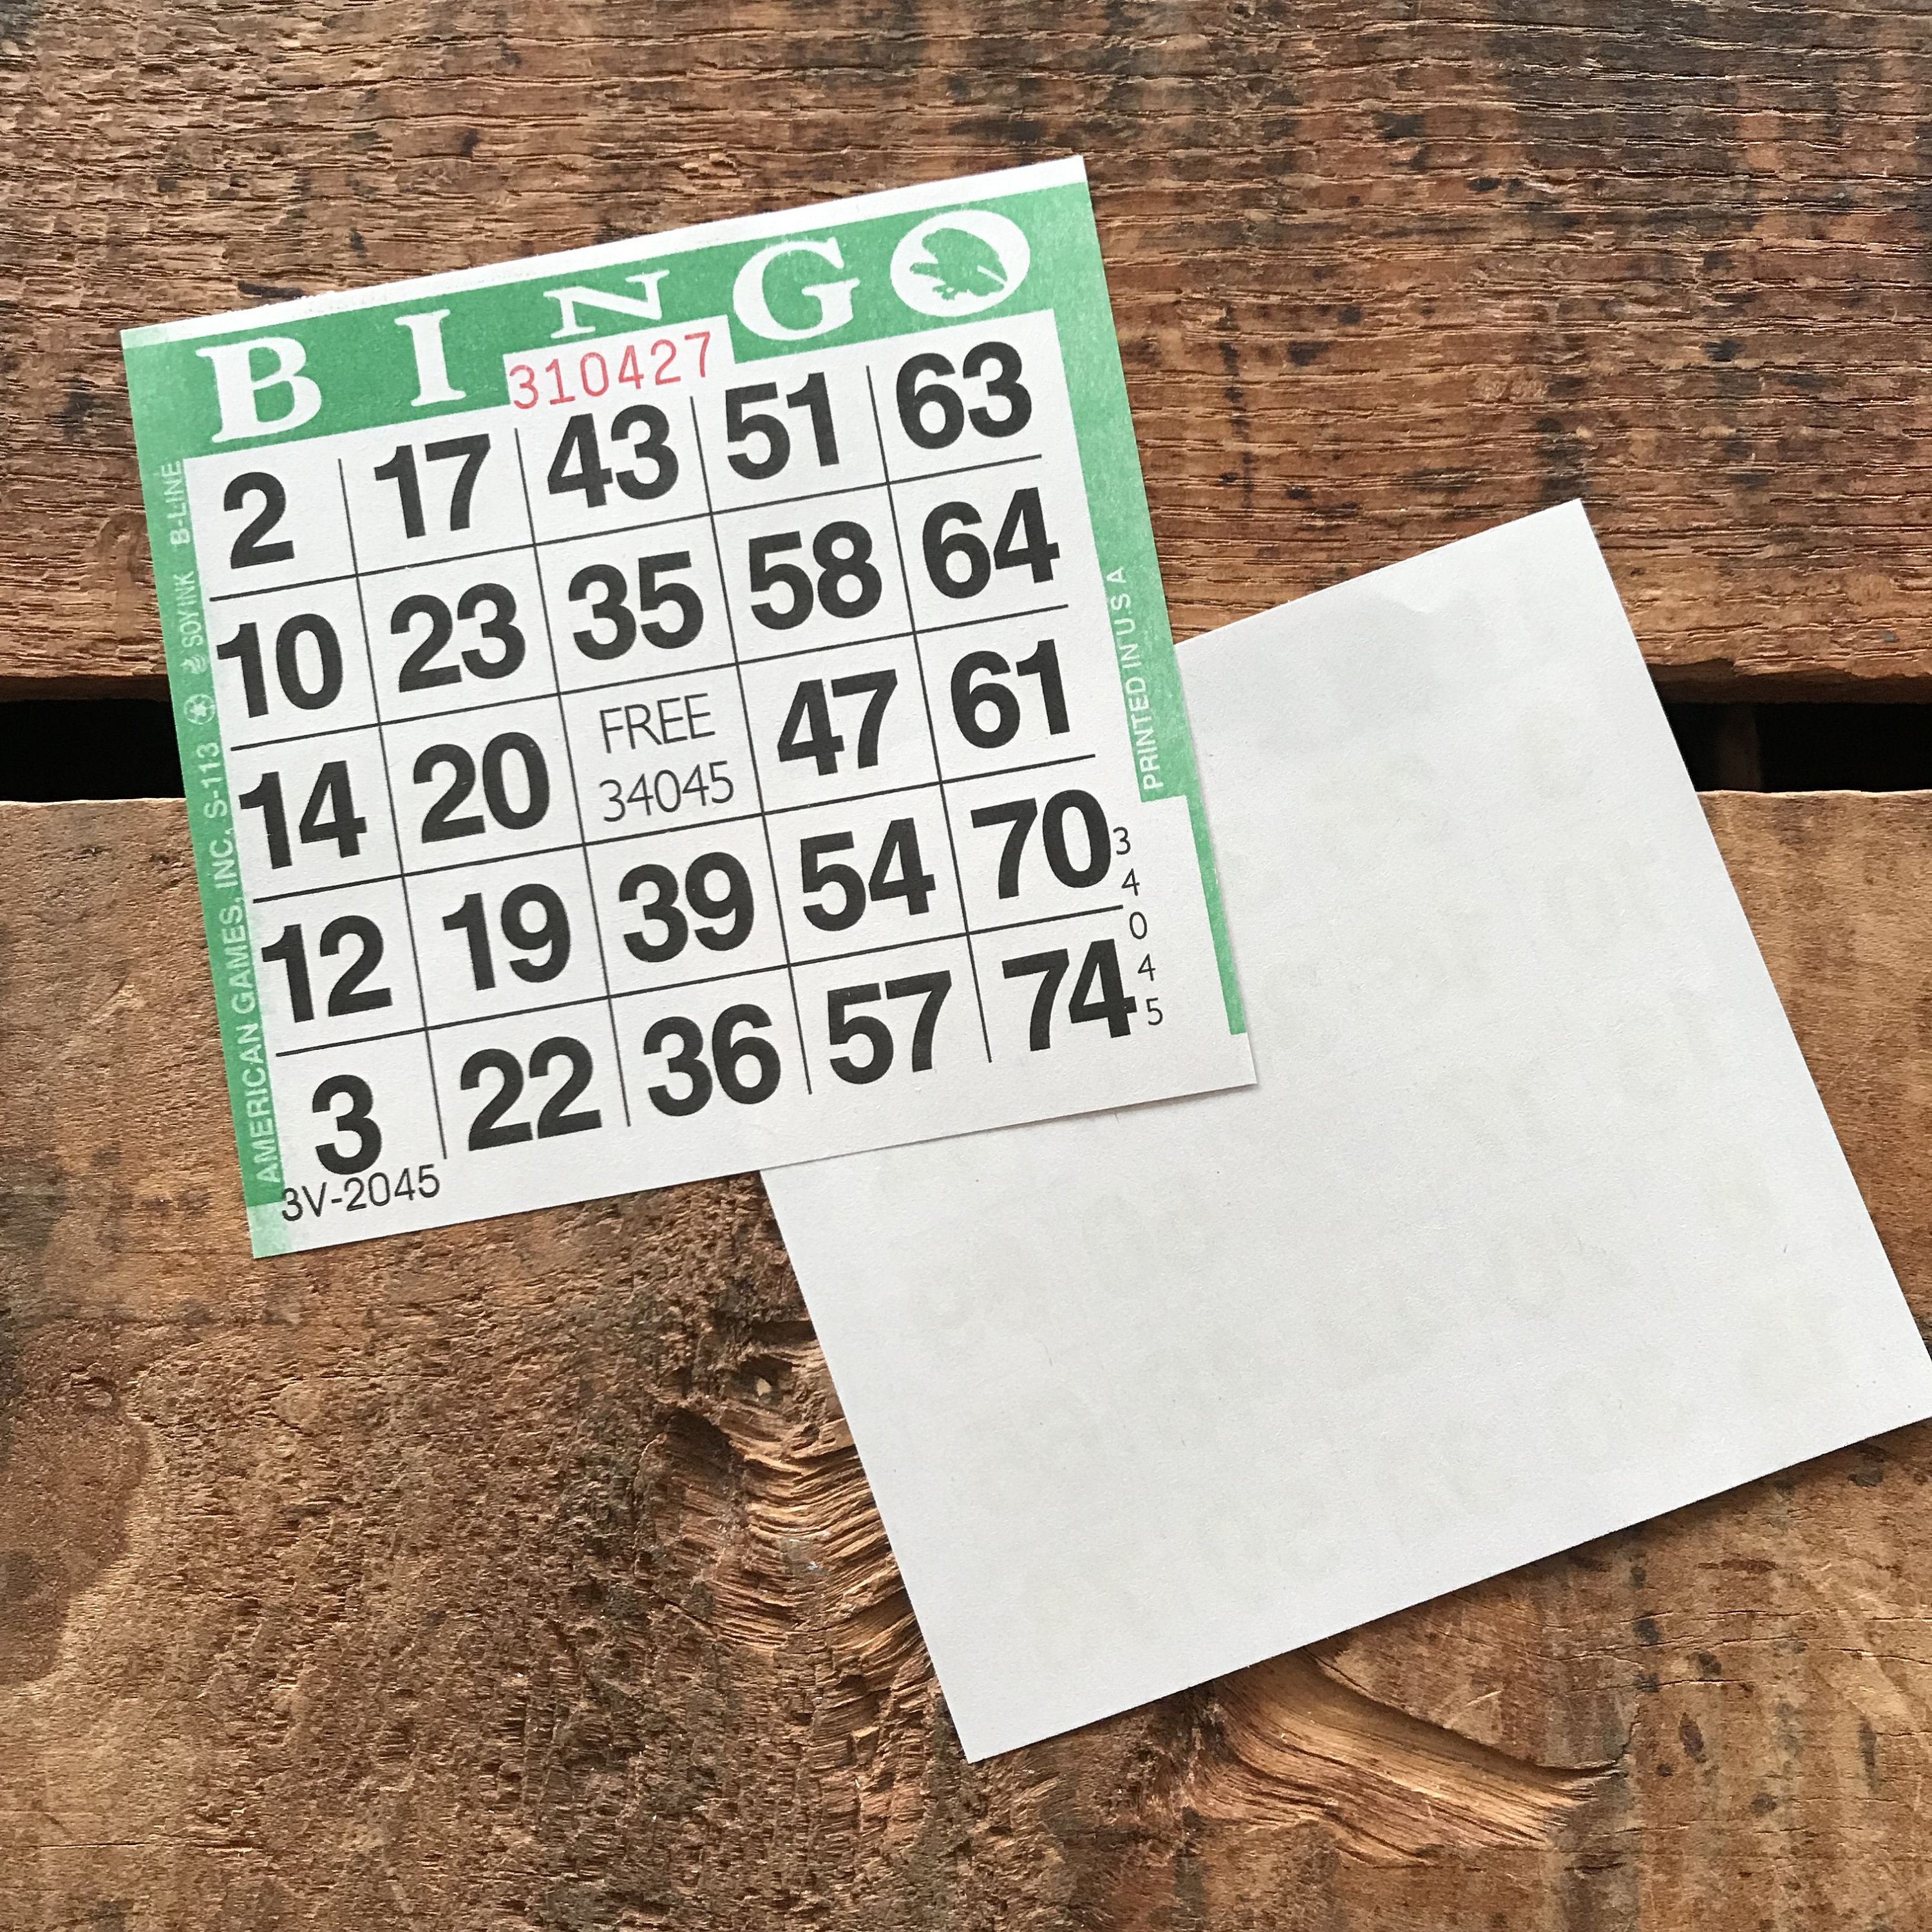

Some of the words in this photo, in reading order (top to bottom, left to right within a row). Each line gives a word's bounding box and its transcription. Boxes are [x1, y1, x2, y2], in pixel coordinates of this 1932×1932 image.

[510, 332, 710, 409] 310427
[161, 460, 191, 545] B-LINE
[224, 472, 294, 569] 2
[374, 434, 490, 538] 17
[547, 405, 678, 507] 43
[726, 373, 838, 479] 51
[896, 342, 1031, 449] 63
[217, 614, 343, 717] 10
[391, 583, 525, 692] 23
[569, 551, 703, 659] 35
[749, 522, 882, 629] 58
[923, 488, 1059, 598] 64
[1119, 643, 1143, 670] IN
[600, 693, 715, 753] FREE
[777, 669, 897, 775] 47
[951, 639, 1070, 748] 61
[1124, 676, 1164, 790] PRINTED
[196, 741, 228, 819] S-113
[239, 761, 366, 869] 14
[413, 732, 549, 843] 20
[599, 761, 734, 822] 34045
[219, 896, 258, 1014] GAMES,
[261, 916, 392, 1023] 12
[442, 884, 571, 990] 19
[619, 853, 753, 962] 39
[800, 818, 935, 931] 54
[971, 790, 1111, 899] 70
[236, 1023, 281, 1184] AMERICAN
[312, 1075, 381, 1175] 3
[460, 1037, 601, 1151] 22
[643, 1005, 781, 1116] 36
[828, 971, 951, 1084] 57
[1002, 939, 1137, 1051] 74
[279, 1164, 440, 1222] 3V-2045
